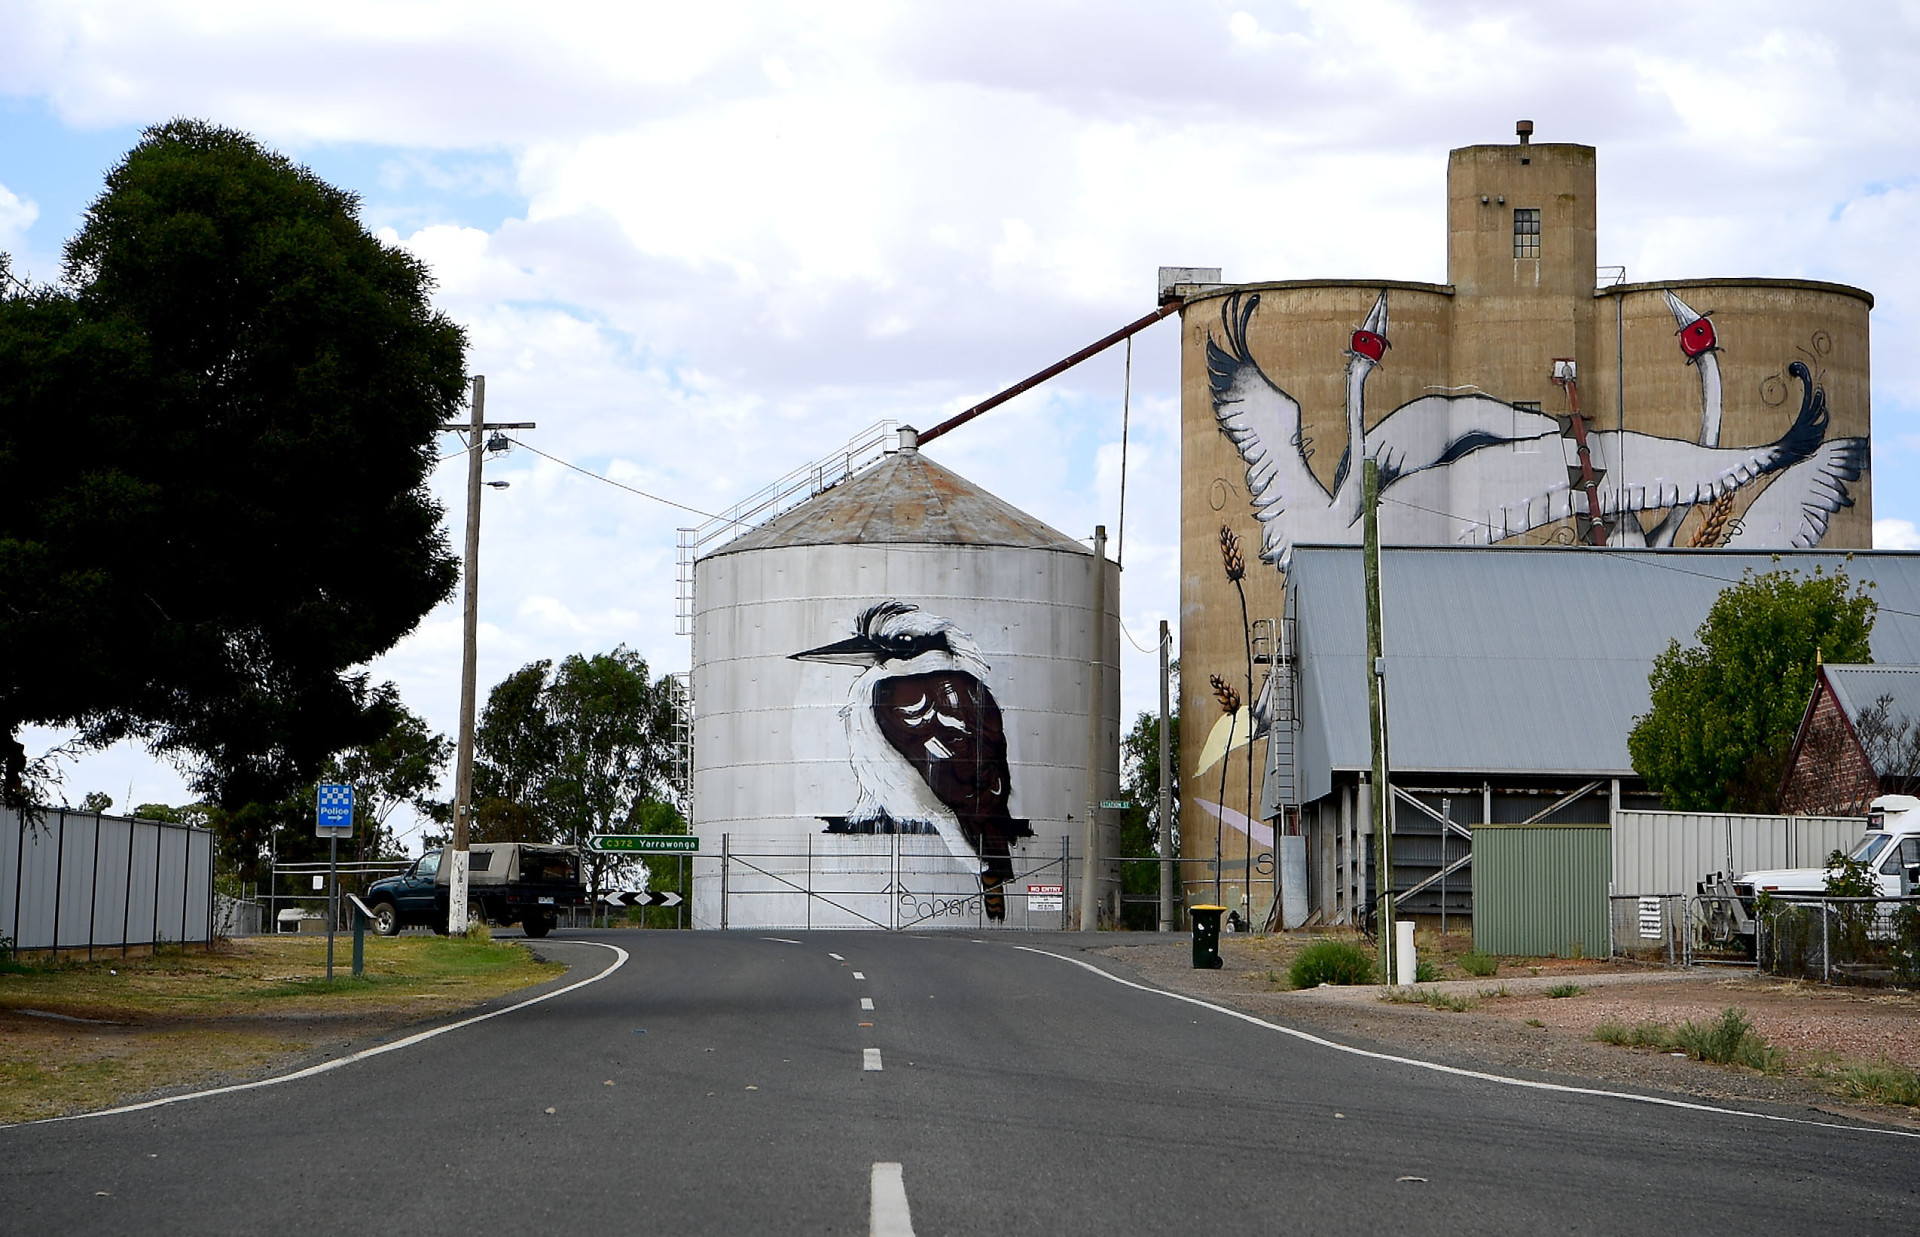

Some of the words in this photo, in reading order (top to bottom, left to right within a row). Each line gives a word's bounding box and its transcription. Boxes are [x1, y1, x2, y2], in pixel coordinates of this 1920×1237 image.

[320, 807, 349, 815] Police
[606, 839, 632, 848] C372
[639, 839, 695, 850] Yarrawonga
